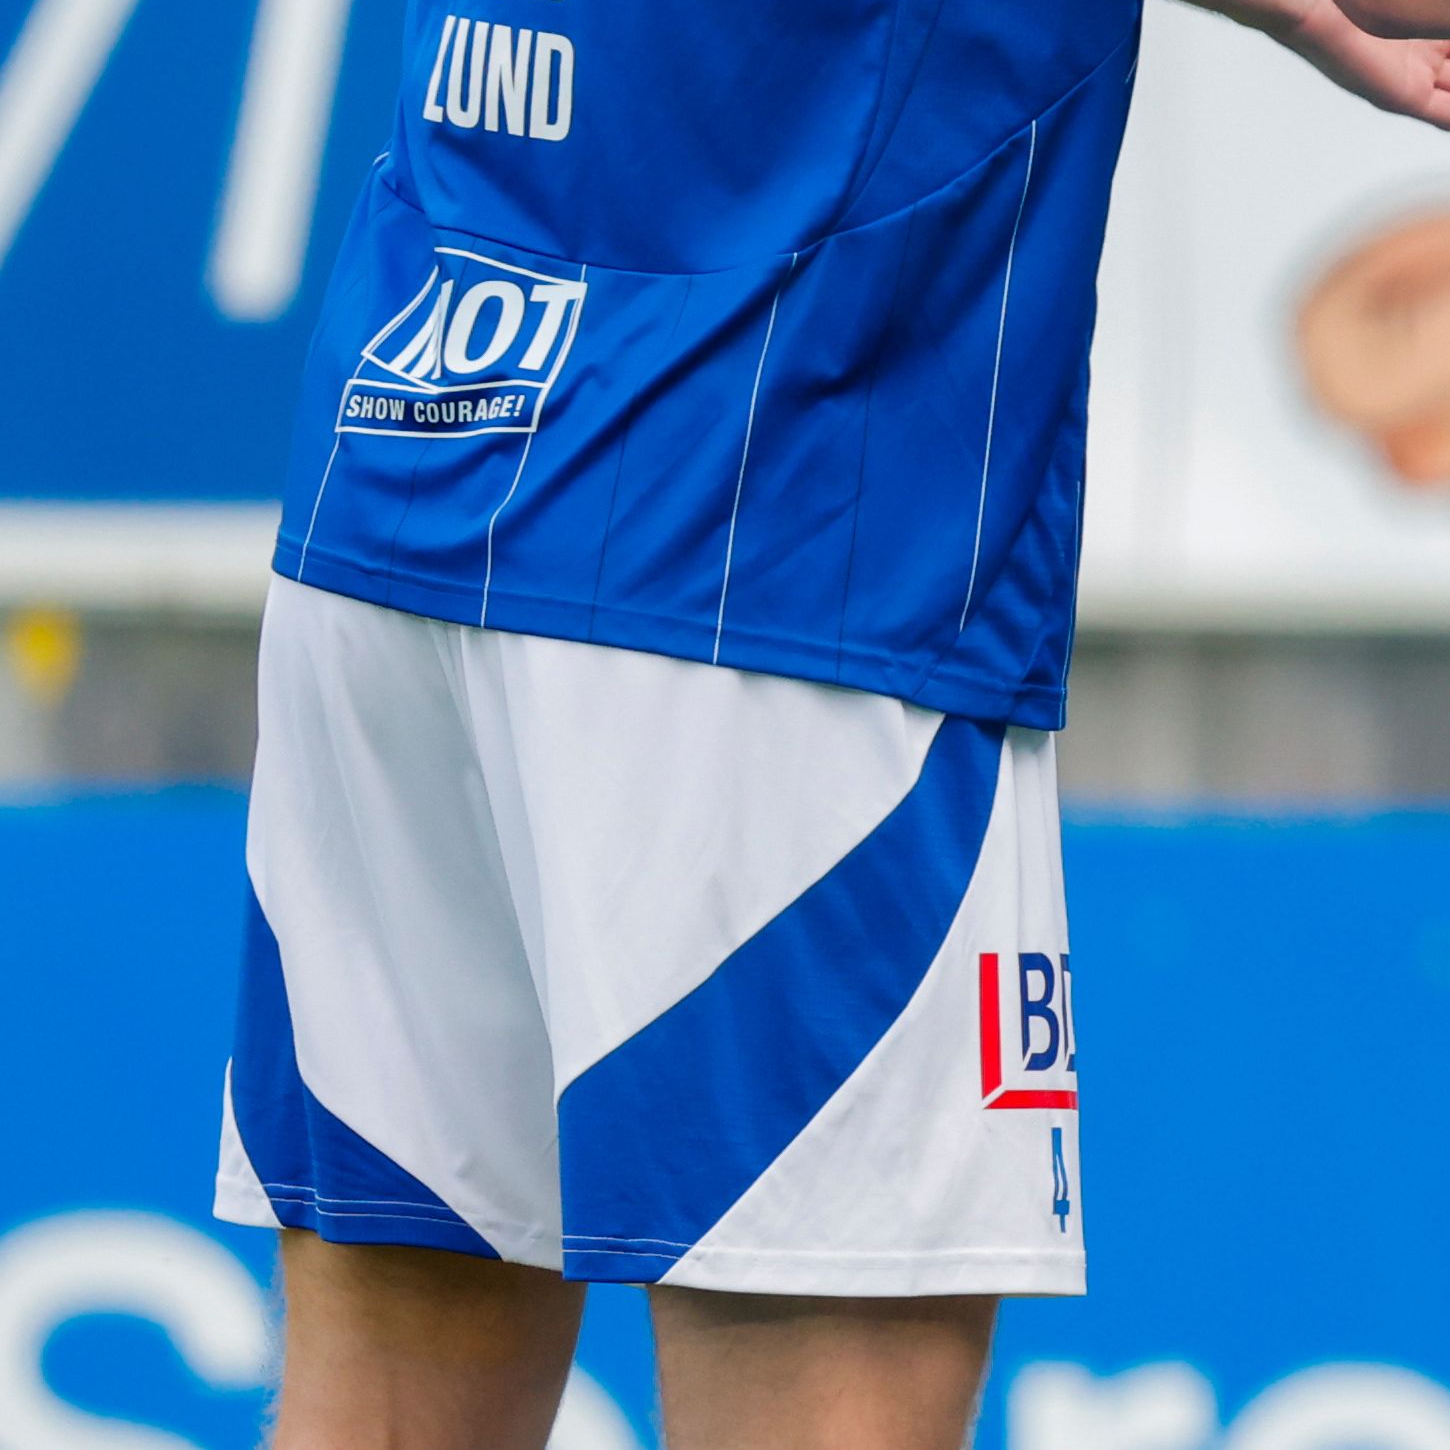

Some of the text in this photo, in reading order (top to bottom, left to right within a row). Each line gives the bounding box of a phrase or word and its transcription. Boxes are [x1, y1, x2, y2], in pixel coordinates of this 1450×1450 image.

[423, 15, 574, 141] LUND
[346, 394, 525, 423] SHOW COURAGE!
[1051, 1127, 1070, 1233] 4
